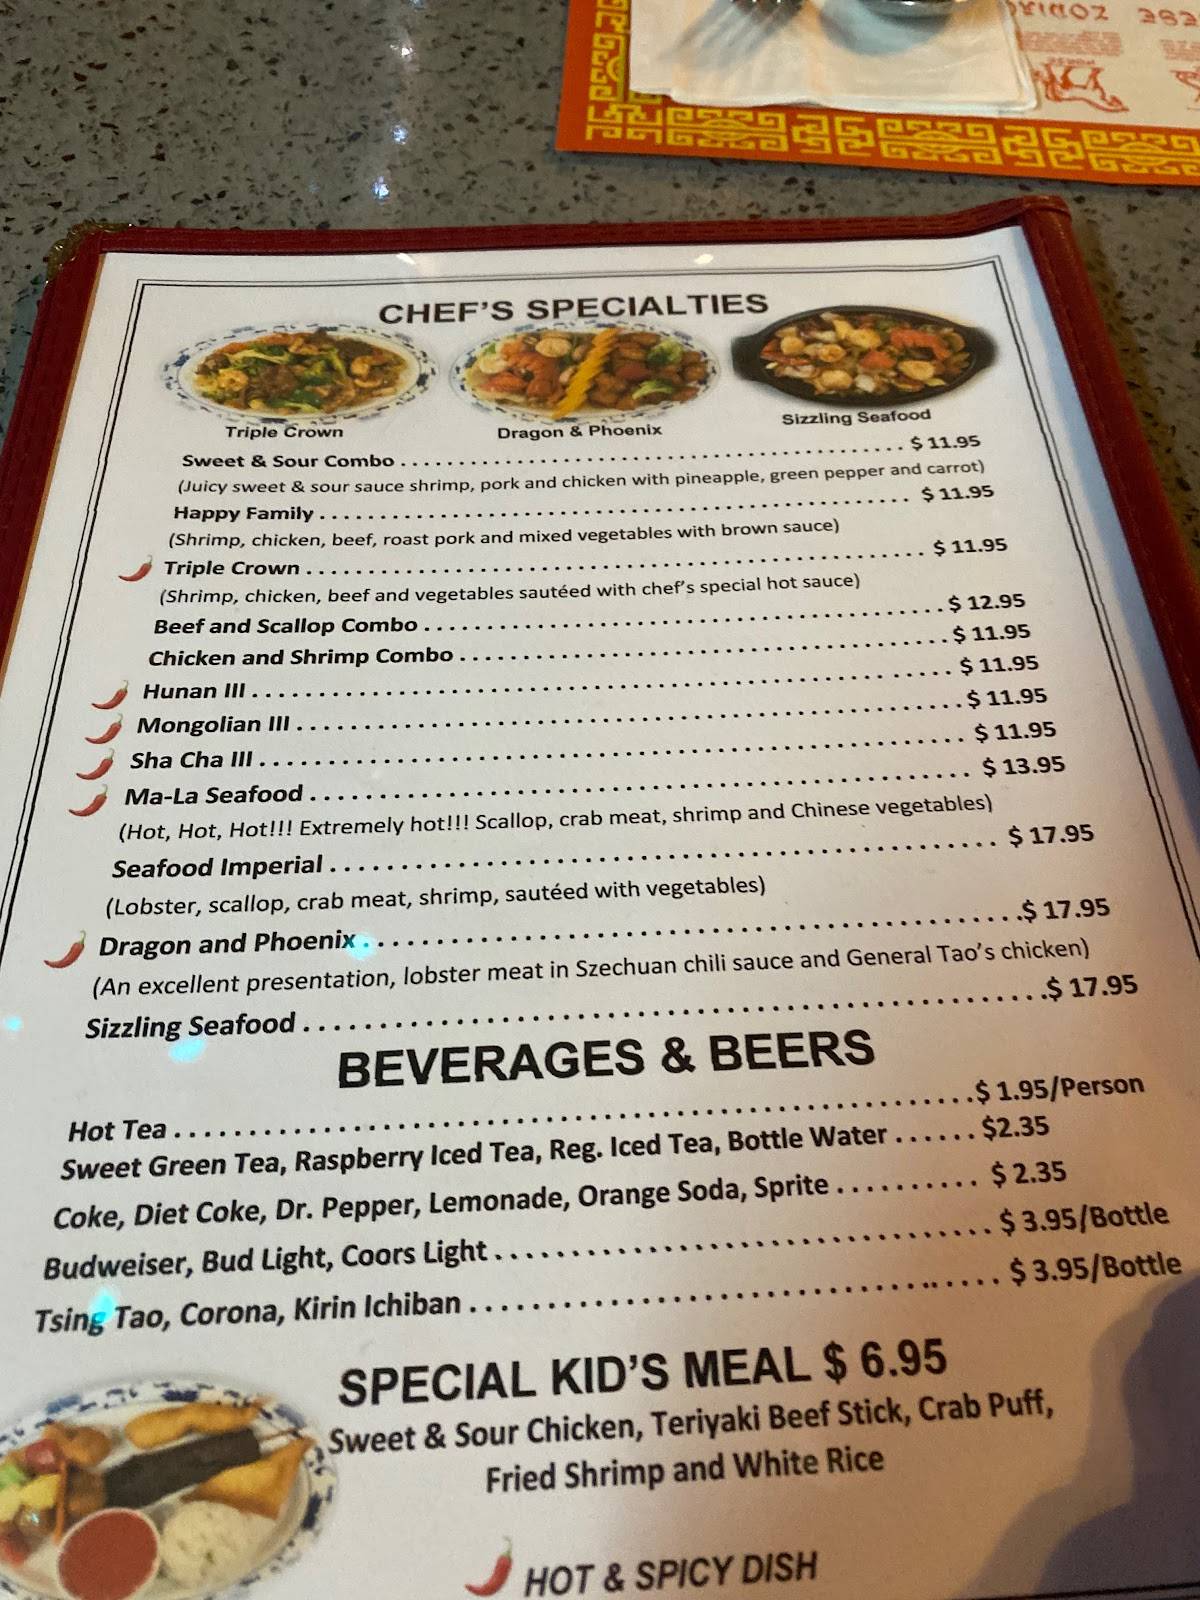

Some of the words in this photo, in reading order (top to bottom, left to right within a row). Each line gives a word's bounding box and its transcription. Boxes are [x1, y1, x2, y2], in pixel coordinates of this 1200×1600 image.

[1138, 8, 1198, 26] ESE
[379, 300, 514, 324] CHEF'S
[526, 293, 769, 320] SPECIALTIES
[225, 425, 278, 441] Triple
[283, 426, 344, 438] Crown
[498, 426, 564, 441] Dragon
[569, 423, 583, 437] &
[586, 420, 663, 437] Phoenix
[782, 412, 852, 426] Sizzling
[857, 408, 931, 423] Seafood
[182, 454, 245, 468] Sweet
[251, 454, 267, 468] &
[272, 455, 319, 468] Sour
[324, 454, 395, 468] Combo
[927, 435, 981, 449] 11.95
[178, 479, 228, 495] (Juicy
[232, 482, 286, 493] sweet
[291, 480, 305, 493] &
[310, 483, 350, 493] sour
[354, 483, 404, 493] sauce
[409, 479, 475, 494] shrimp,
[481, 477, 520, 493] pork
[525, 476, 557, 489] and
[562, 474, 626, 488] chicken
[632, 473, 670, 486] with
[675, 470, 765, 488] pineapple,
[770, 470, 819, 484] green
[824, 467, 885, 481] pepper
[890, 463, 922, 476] and
[927, 459, 985, 475] carrot)
[169, 532, 245, 549] (Shrimp,
[251, 533, 326, 549] chicken,
[332, 532, 377, 548] beef,
[383, 534, 429, 546] roast
[434, 531, 475, 548] pork
[480, 530, 513, 544] and
[519, 529, 572, 543] mixed
[577, 526, 673, 544] vegetables
[677, 524, 716, 538] with
[721, 523, 778, 536] brown
[783, 518, 839, 534] sauce)
[160, 589, 239, 606] (Shrimp,
[245, 588, 321, 605] chicken,
[328, 588, 371, 603] beef
[375, 588, 409, 602] and
[415, 586, 514, 604] vegetables
[519, 584, 591, 599] sautéed
[596, 582, 636, 597] with
[642, 580, 695, 596] chef's
[700, 577, 761, 596] special
[767, 576, 798, 590] hot
[802, 572, 860, 590] sauce)
[154, 618, 206, 634] Beef
[209, 618, 252, 634] and
[256, 617, 335, 637] Scallop
[341, 617, 418, 633] Combo
[967, 593, 1026, 611] 12.95
[137, 715, 261, 737] Mongolian
[268, 715, 290, 732] III
[986, 688, 1048, 706] 11.95
[124, 787, 199, 806] Ma-La
[205, 783, 304, 804] Seafood
[1002, 755, 1066, 775] 13.95
[119, 823, 170, 843] (Hot,
[178, 823, 222, 841] Hot,
[229, 819, 292, 838] Hot!!!
[300, 816, 405, 836] Extremely
[410, 814, 468, 832] hot!!!
[475, 812, 553, 831] Scallop,
[559, 809, 603, 827] crab
[609, 809, 667, 826] meat,
[673, 806, 742, 824] shrimp
[748, 802, 785, 820] and
[791, 801, 870, 818] Chinese
[875, 793, 993, 817] vegetables)
[99, 937, 191, 961] Dragon
[198, 932, 247, 954] and
[254, 929, 356, 952] Phoenix
[1043, 897, 1111, 920] 17.95
[93, 976, 130, 1000] (An
[138, 974, 240, 995] excellent
[246, 969, 396, 996] presentation,
[404, 965, 481, 985] lobster
[488, 962, 544, 981] meat
[550, 960, 569, 979] in
[576, 957, 677, 978] Szechuan
[684, 953, 726, 973] chili
[732, 955, 794, 971] sauce
[800, 948, 840, 968] and
[846, 945, 932, 966] General
[936, 942, 995, 962] Tao's
[1001, 937, 1089, 960] chicken)
[338, 1038, 645, 1089] BEVERAGES
[661, 1036, 696, 1074] &
[709, 1029, 876, 1072] BEERS
[68, 1121, 116, 1142] Hot
[122, 1119, 167, 1140] Tea
[996, 1075, 1145, 1103] 1.95/Person
[60, 1157, 142, 1181] Sweet
[148, 1155, 227, 1177] Green
[234, 1152, 287, 1176] Tea,
[295, 1146, 424, 1175] Raspberry
[431, 1141, 482, 1166] Iced
[489, 1141, 542, 1165] Tea,
[550, 1138, 603, 1164] Reg.
[611, 1132, 661, 1157] Iced
[667, 1133, 721, 1156] Tea,
[727, 1127, 803, 1152] Bottle
[808, 1125, 888, 1148] Water
[981, 1114, 1050, 1142] $2.35
[53, 1204, 125, 1231] Coke,
[134, 1202, 190, 1226] Diet
[196, 1199, 267, 1226] Coke,
[276, 1198, 313, 1220] Dr.
[322, 1196, 421, 1223] Pepper,
[429, 1185, 570, 1214] Lemonade,
[578, 1184, 671, 1210] Orange
[677, 1177, 747, 1203] Soda,
[754, 1173, 829, 1203] Sprite
[1012, 1160, 1067, 1184] 2.35
[338, 1360, 537, 1408] SPECIAL
[552, 1352, 670, 1396] KID'S
[683, 1346, 812, 1389] MEAL
[860, 1337, 947, 1379] 6.95
[327, 1426, 416, 1455] Sweet
[424, 1422, 447, 1450] &
[454, 1421, 519, 1448] Sour
[527, 1413, 643, 1444] Chicken,
[650, 1404, 761, 1440] Teriyaki
[768, 1399, 831, 1430] Beef
[837, 1396, 912, 1428] Stick,
[918, 1392, 982, 1422] Crab
[987, 1387, 1054, 1420] Puff,
[486, 1461, 556, 1494] Fried
[564, 1458, 665, 1491] Shrimp
[673, 1452, 726, 1483] and
[732, 1448, 819, 1479] White
[826, 1445, 884, 1474] Rice
[524, 1564, 595, 1598] HOT
[603, 1562, 625, 1593] &
[635, 1555, 735, 1591] SPICY
[741, 1550, 818, 1585] DISH
